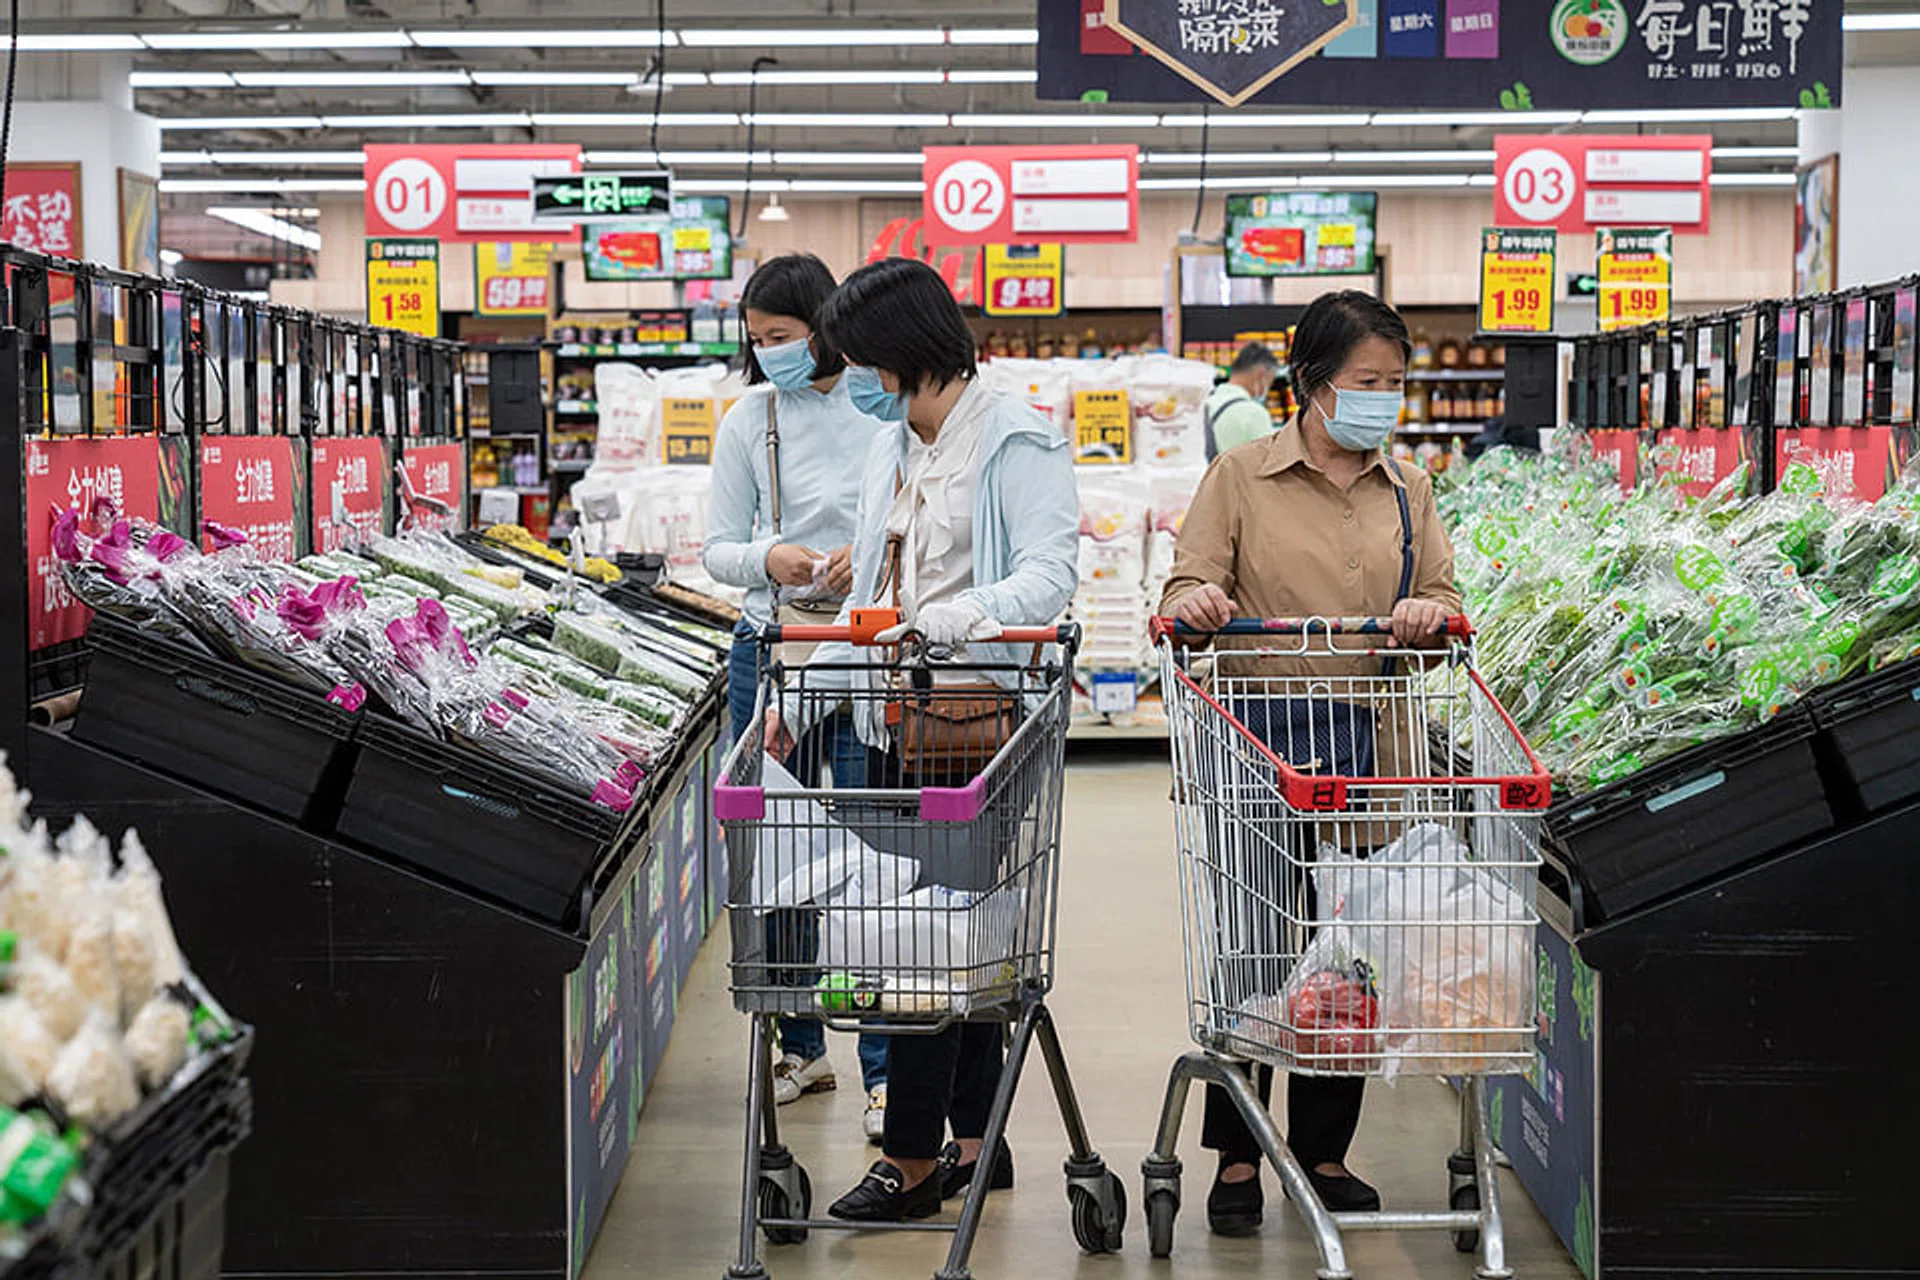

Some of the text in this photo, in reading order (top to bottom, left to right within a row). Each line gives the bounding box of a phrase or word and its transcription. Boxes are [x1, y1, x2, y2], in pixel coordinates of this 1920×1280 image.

[1178, 6, 1285, 54] 隔夜菜
[1389, 13, 1434, 33] 星期六
[1450, 13, 1494, 33] 星期日
[385, 176, 432, 215] 01
[943, 178, 994, 216] 02
[1512, 167, 1564, 205] 03
[381, 292, 422, 321] 1.58
[1491, 288, 1541, 319] 1.99
[1608, 288, 1658, 319] 1.99
